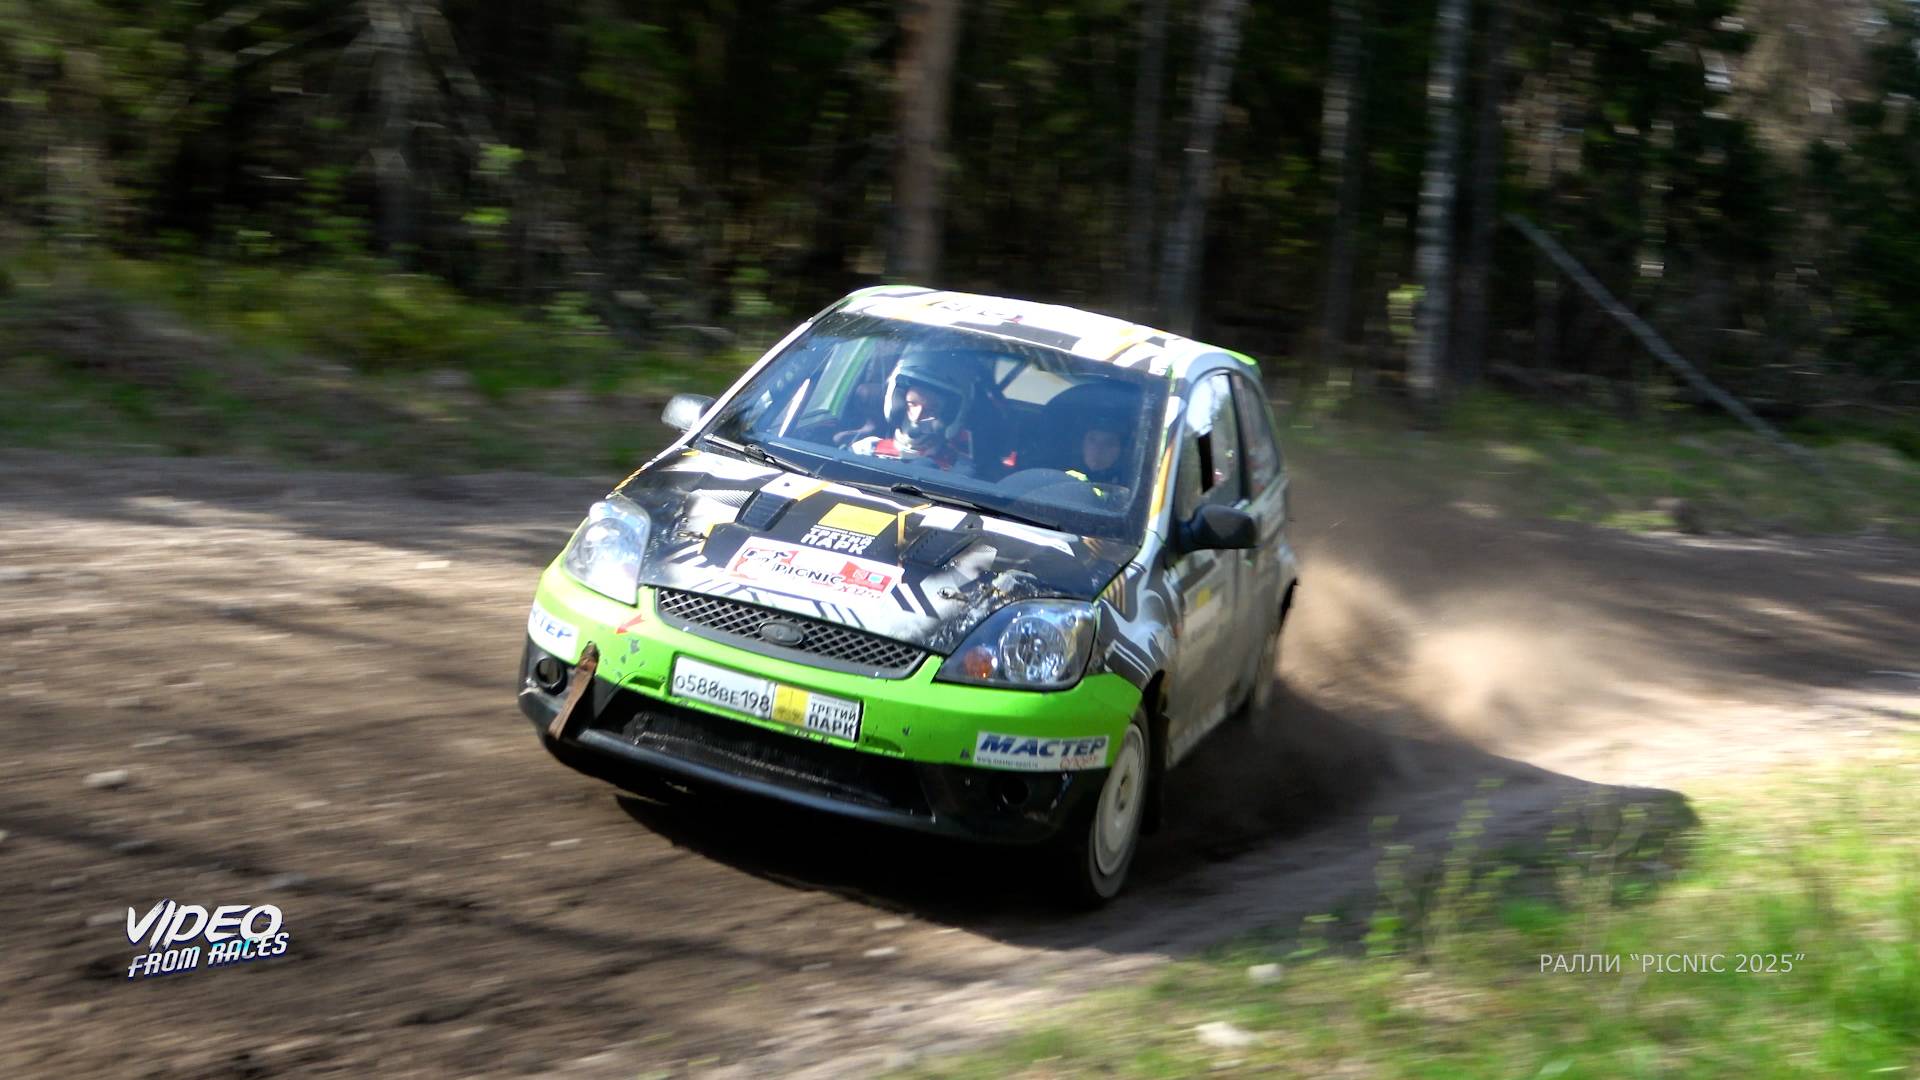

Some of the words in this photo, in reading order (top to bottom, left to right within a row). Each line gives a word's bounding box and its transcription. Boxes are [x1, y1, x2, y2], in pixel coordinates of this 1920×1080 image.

[800, 533, 867, 555] ПАРК
[810, 527, 873, 546] ТРЕТИЙ
[775, 563, 843, 584] PICNIC
[811, 701, 857, 721] ТРЕТИЙ
[808, 713, 857, 736] ПАРК
[980, 734, 1107, 757] МАСТЕР
